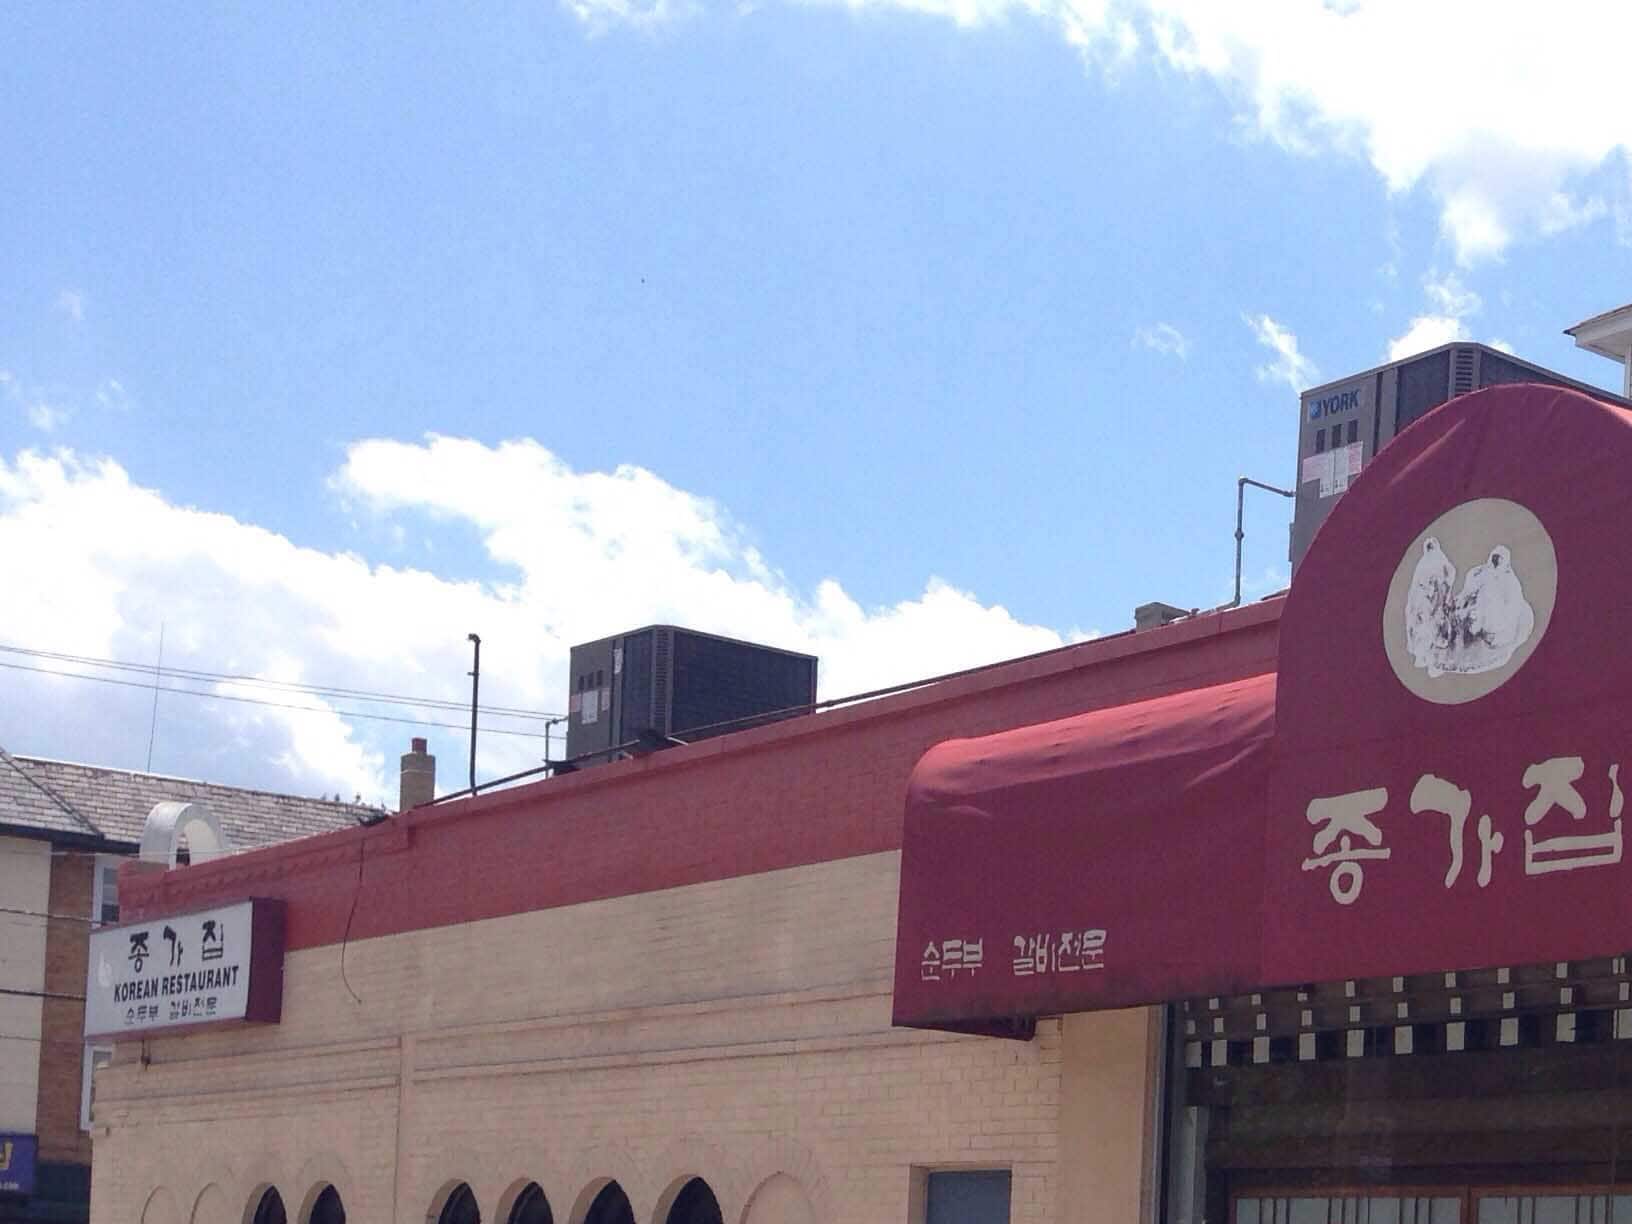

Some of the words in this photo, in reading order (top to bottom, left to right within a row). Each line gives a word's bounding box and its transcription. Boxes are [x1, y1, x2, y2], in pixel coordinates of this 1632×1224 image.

[1322, 390, 1359, 416] YORK
[920, 937, 983, 981] 순두부
[1013, 929, 1107, 976] 갈비전문
[114, 977, 159, 1003] KOREAN
[161, 965, 239, 997] RESTAURANT
